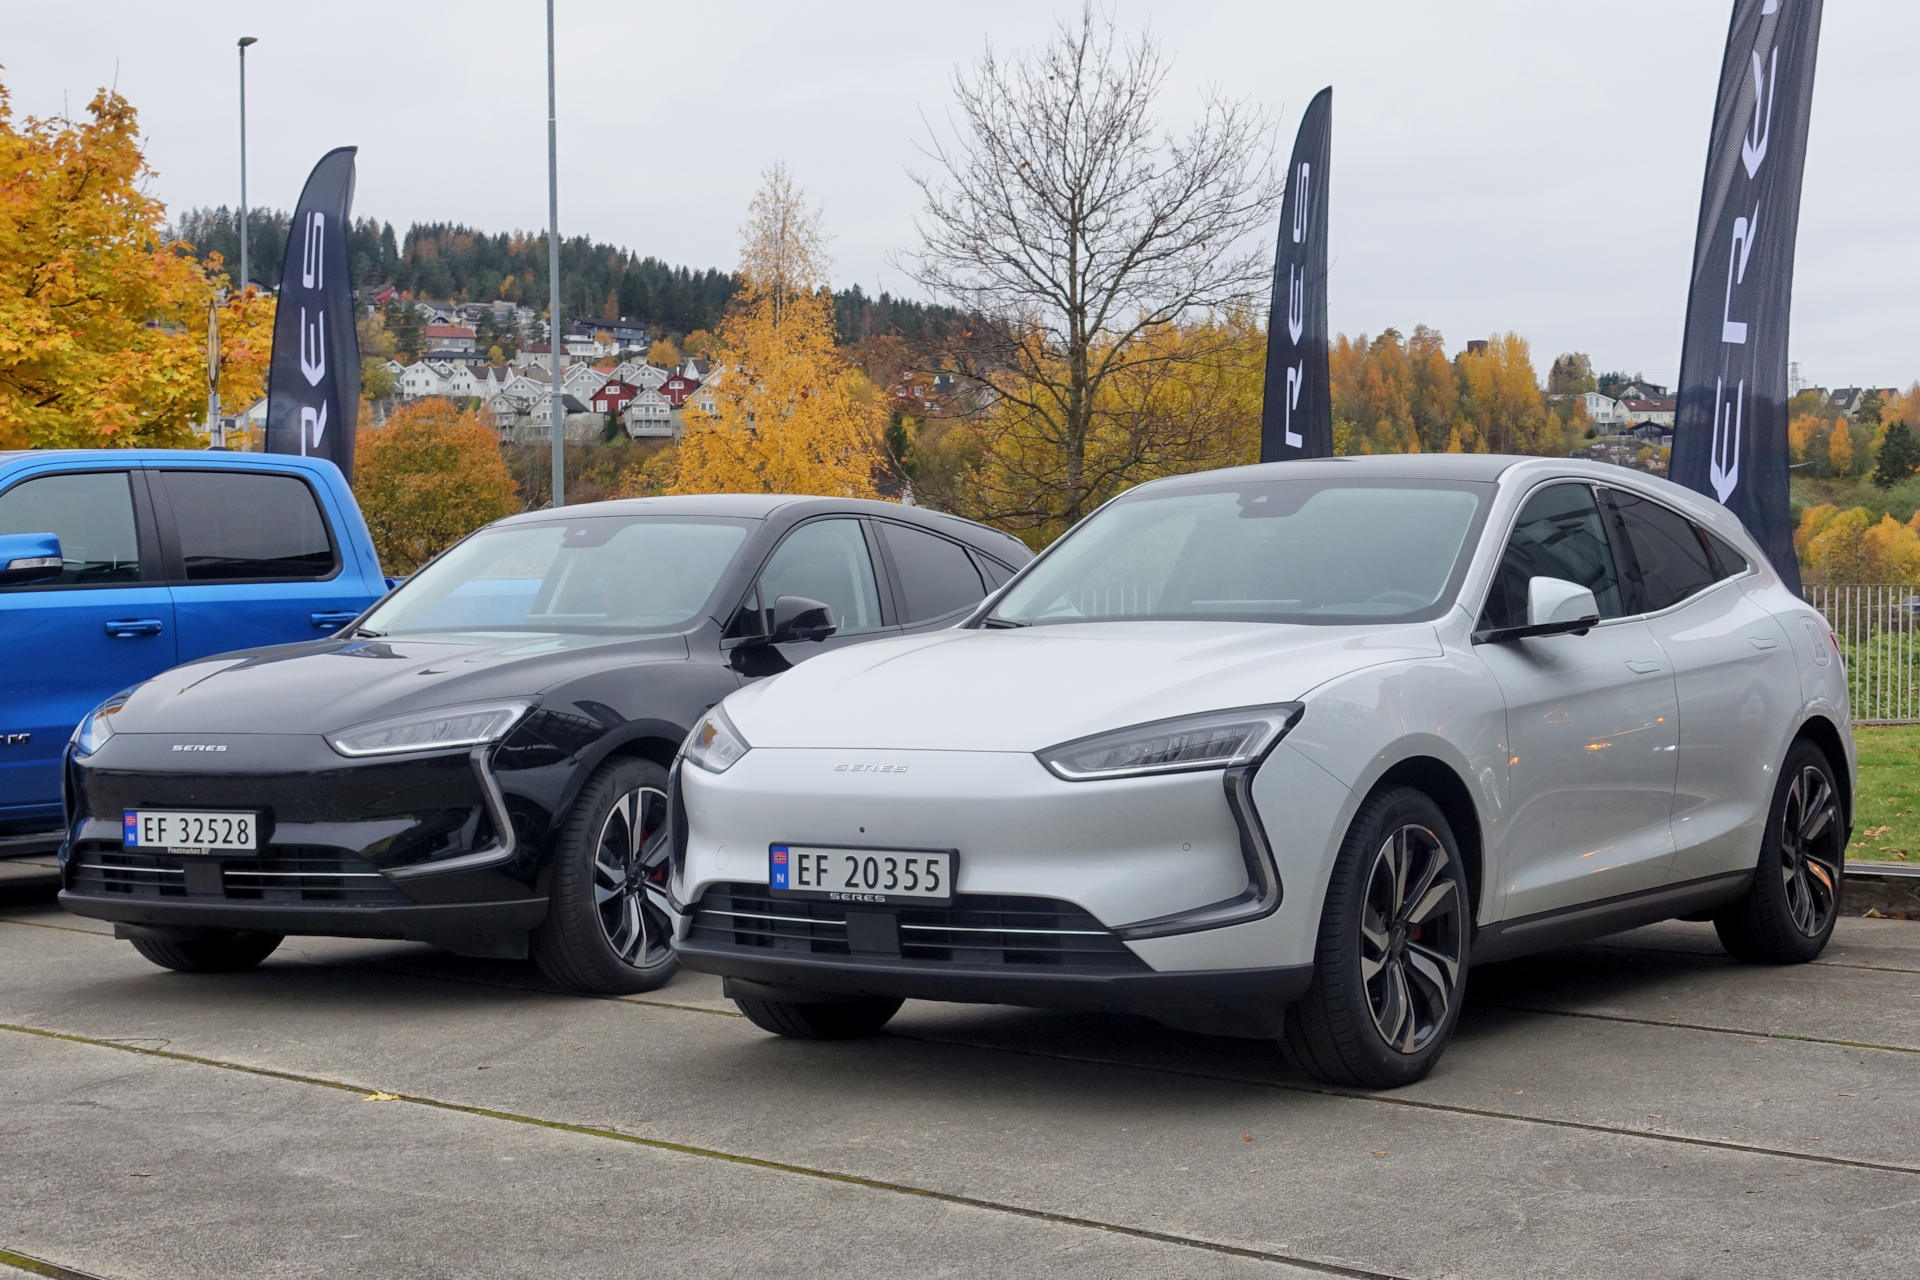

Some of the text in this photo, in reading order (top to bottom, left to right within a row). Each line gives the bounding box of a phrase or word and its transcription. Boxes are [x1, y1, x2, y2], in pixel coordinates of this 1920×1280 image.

[1709, 0, 1778, 504] ERE
[832, 762, 909, 774] SERES
[144, 817, 249, 844] EF 32528
[776, 873, 785, 884] N
[797, 853, 940, 893] EF 20355
[829, 892, 886, 903] SERES
